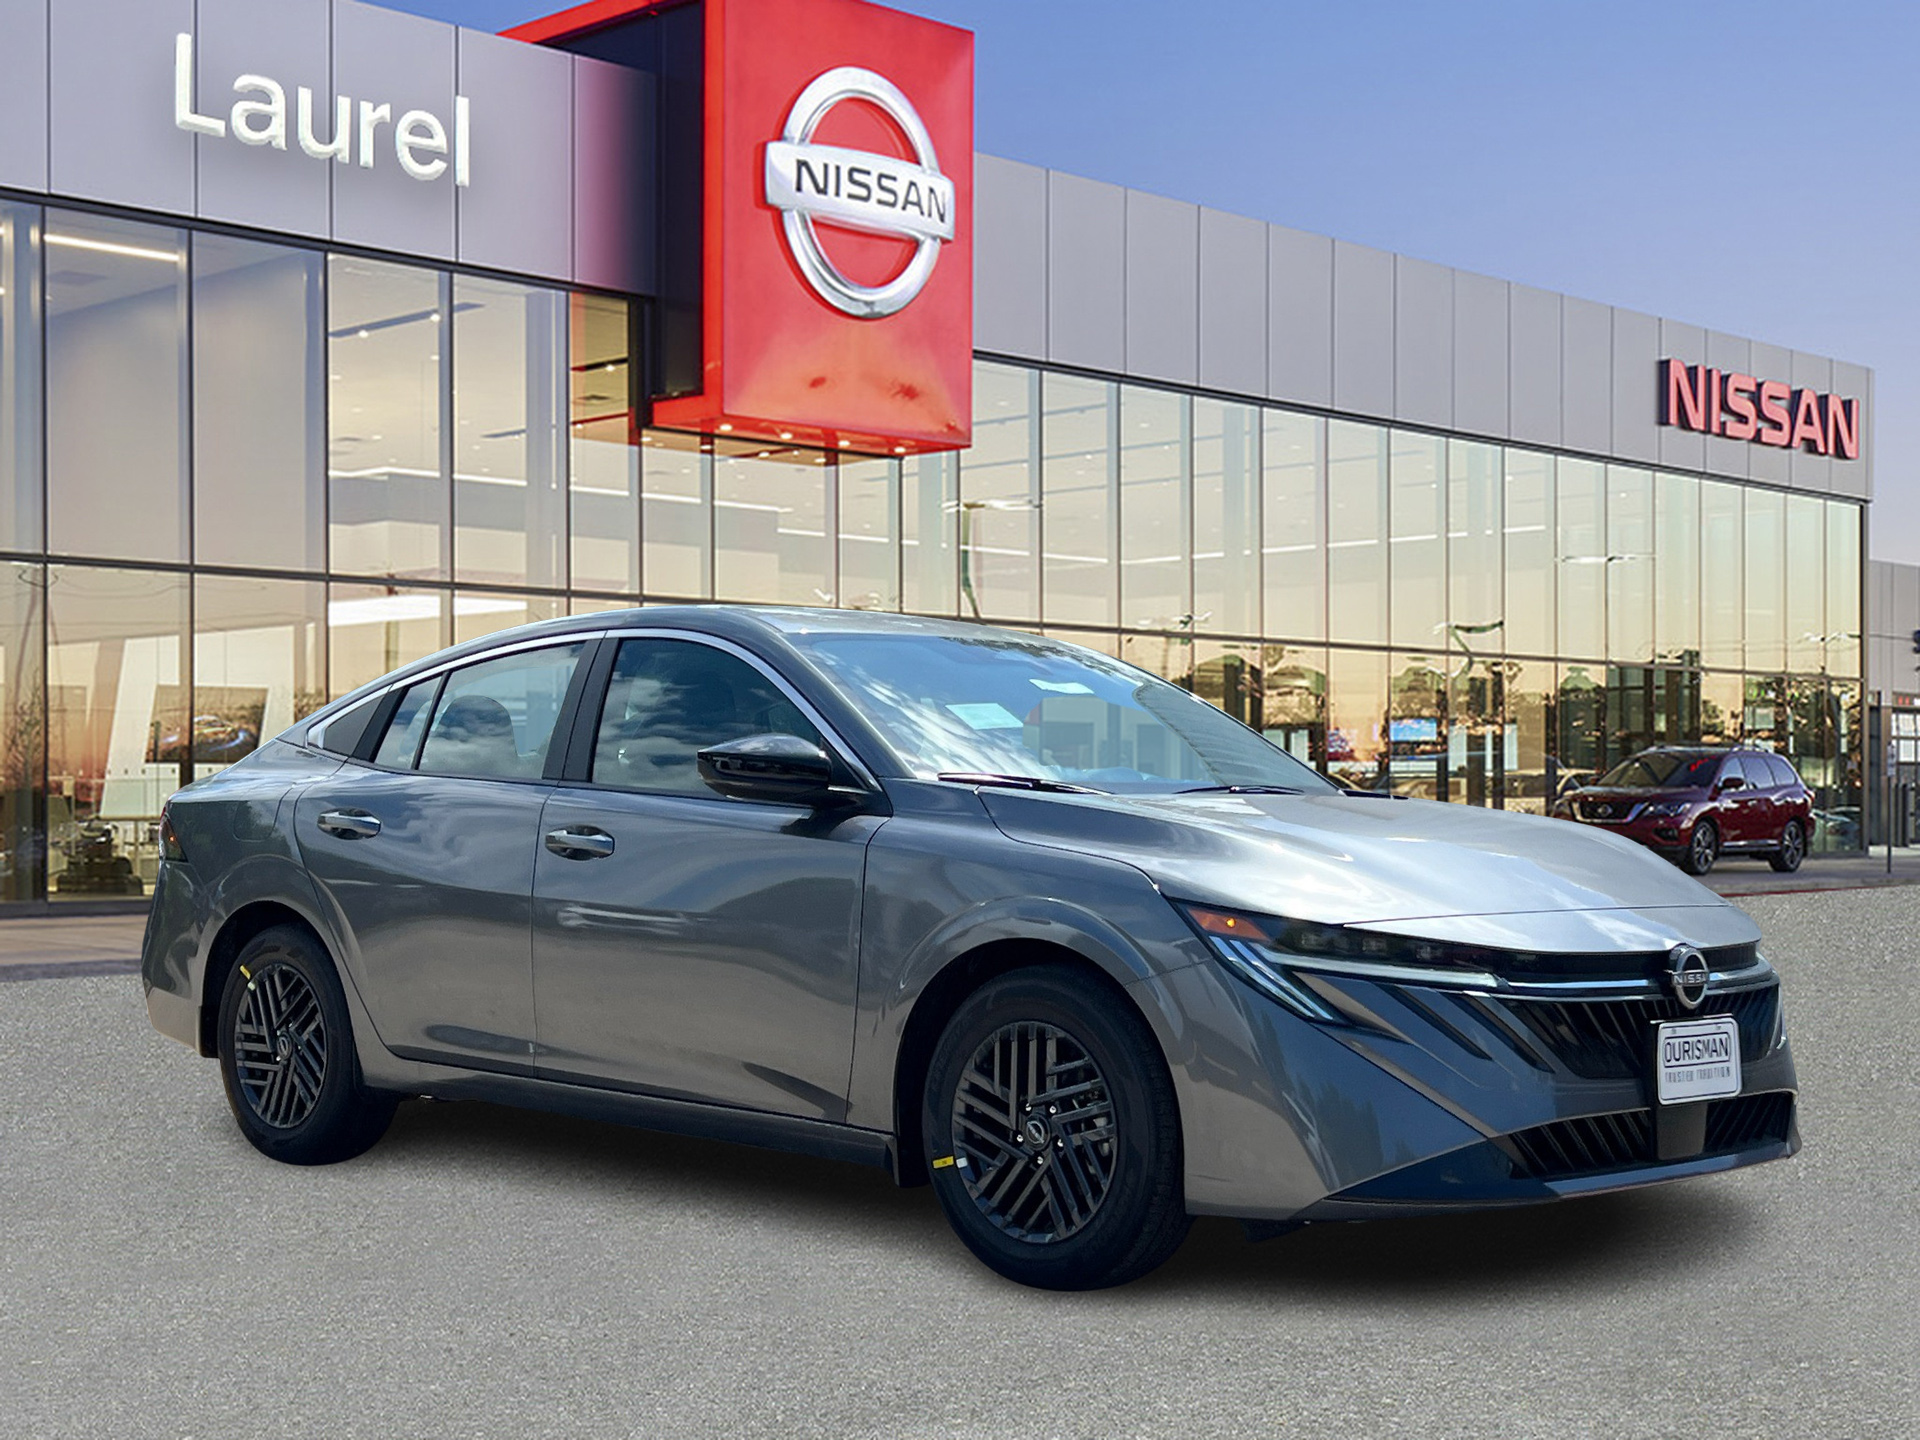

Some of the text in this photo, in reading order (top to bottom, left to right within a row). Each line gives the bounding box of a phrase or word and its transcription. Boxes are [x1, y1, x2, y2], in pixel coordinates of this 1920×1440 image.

[174, 32, 470, 188] Laurel
[795, 158, 946, 224] NISSAN
[1657, 358, 1859, 460] NISSAN
[1664, 1037, 1728, 1062] OURISMAN
